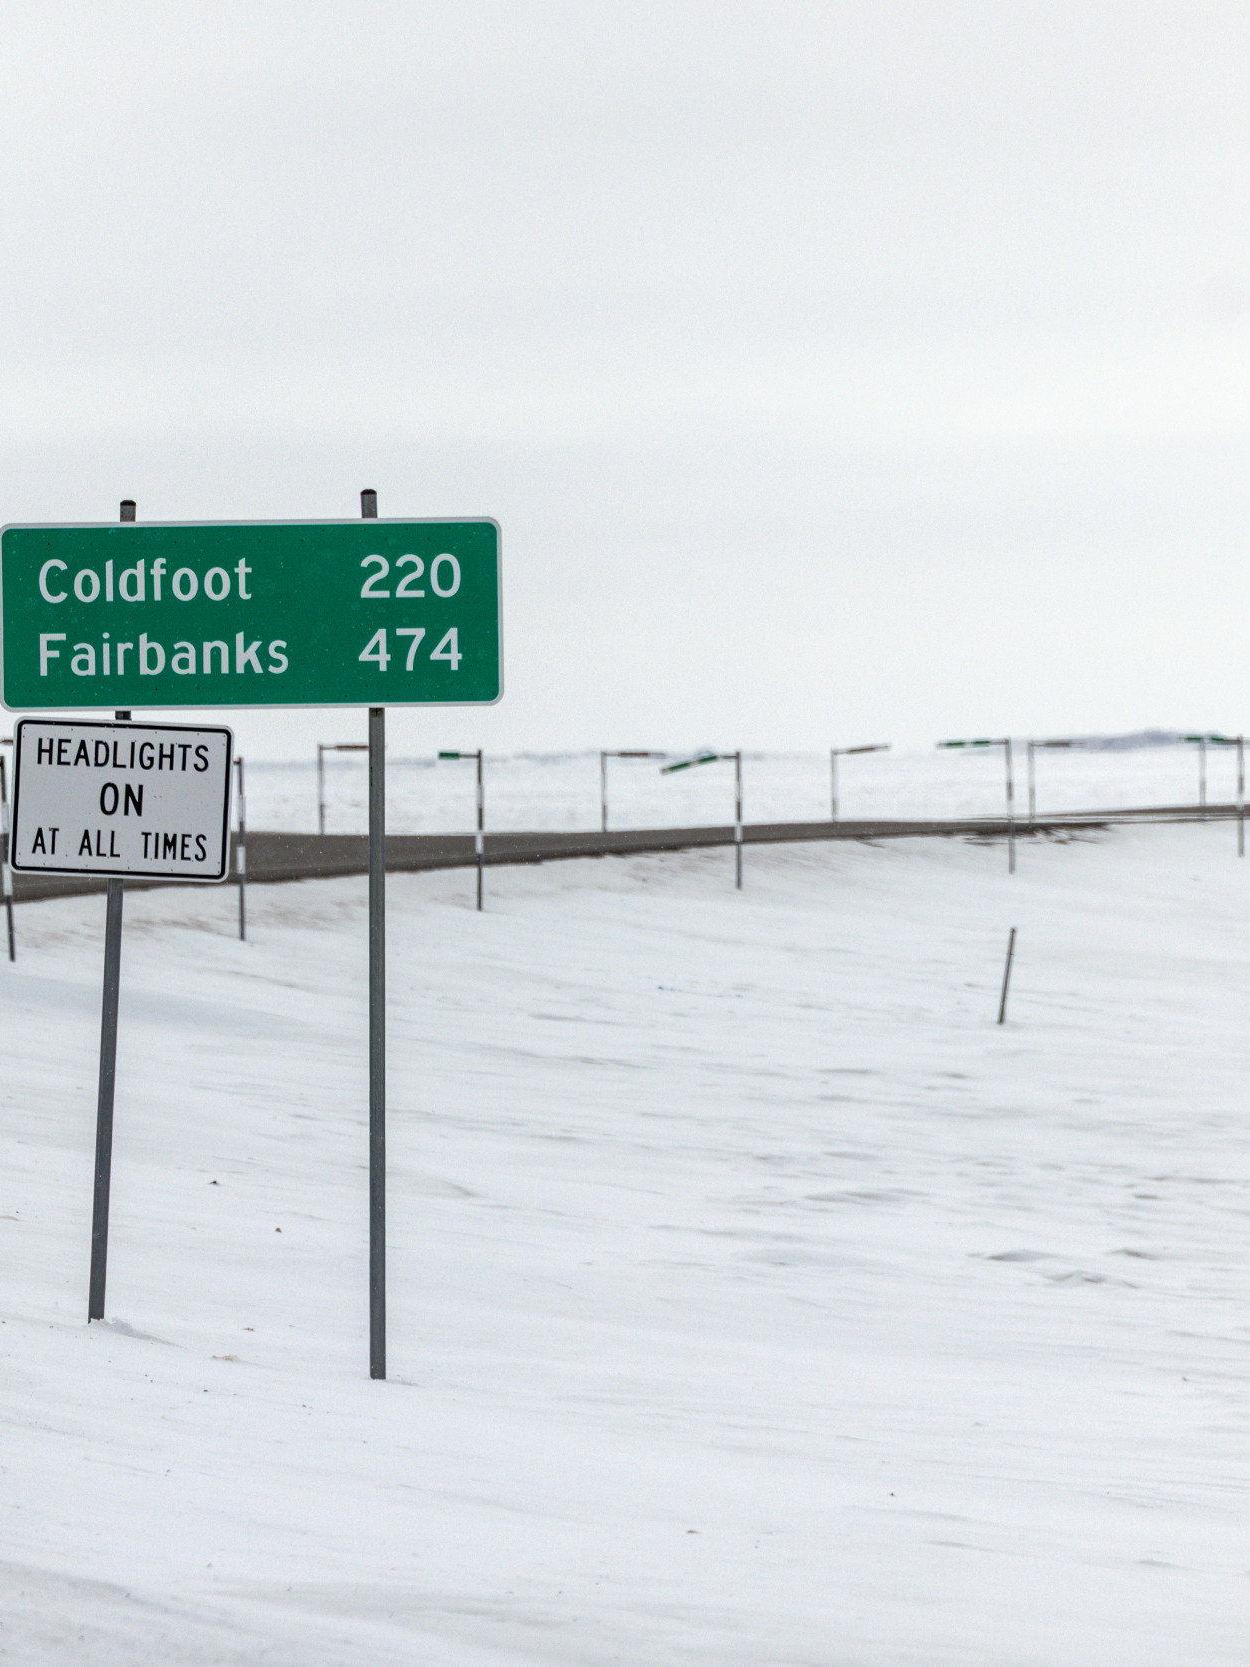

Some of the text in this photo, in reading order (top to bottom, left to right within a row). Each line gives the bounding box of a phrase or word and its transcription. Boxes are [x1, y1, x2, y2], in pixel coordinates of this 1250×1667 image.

[39, 553, 460, 603] Coldfoot 220
[40, 628, 462, 676] Fairbanks 474
[38, 738, 208, 772] HEADLIGHTS
[100, 782, 143, 816] ON
[32, 827, 206, 861] AT ALL TIMES
